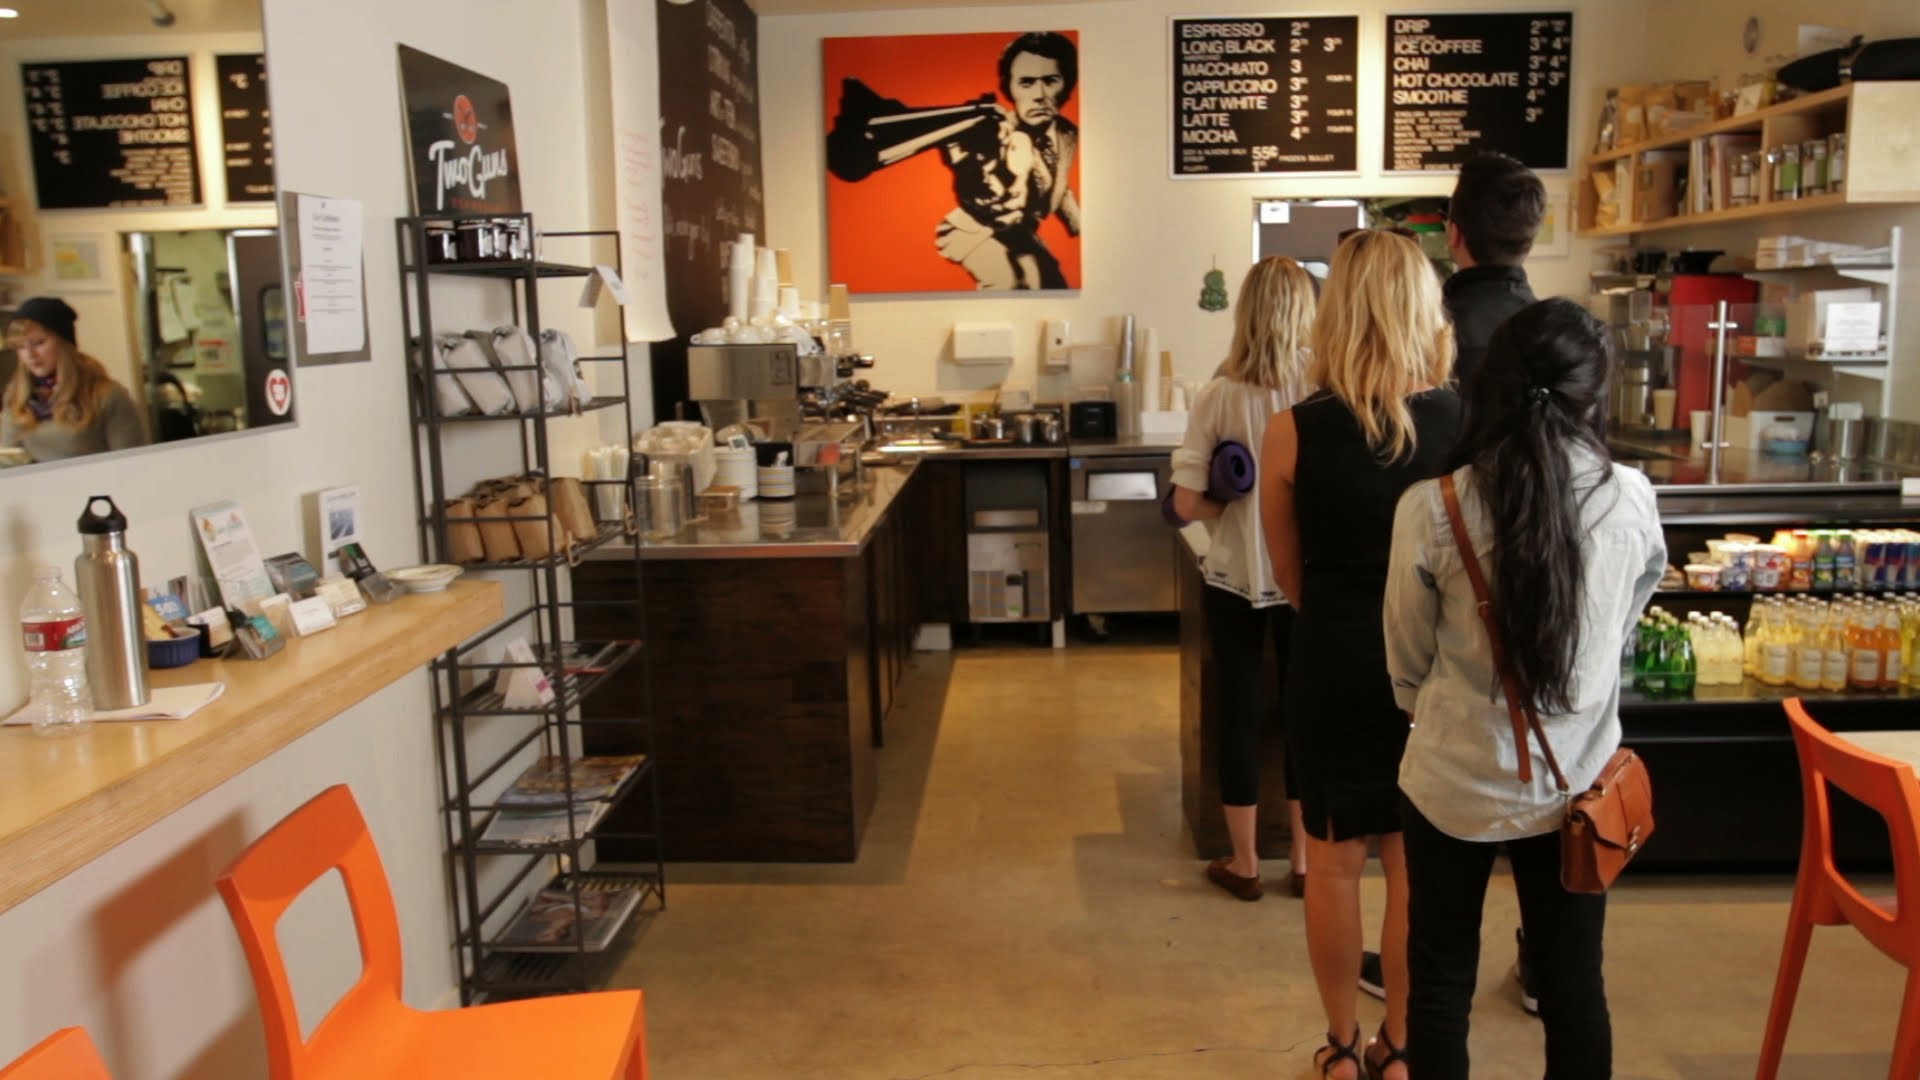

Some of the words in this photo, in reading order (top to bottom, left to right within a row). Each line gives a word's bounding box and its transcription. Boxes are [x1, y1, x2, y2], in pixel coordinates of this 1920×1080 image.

[1182, 23, 1264, 37] ESPRESSO
[1394, 20, 1429, 33] DRIP
[1181, 40, 1224, 54] LONG
[1226, 39, 1275, 53] BLACK
[1394, 41, 1419, 54] ICE
[1421, 39, 1482, 54] COFFEE
[1182, 62, 1269, 76] MACCHIATO
[1393, 57, 1429, 70] CHAI
[1183, 80, 1278, 94] CAPPUCCINO
[1393, 74, 1426, 87] HOT
[1427, 73, 1519, 87] CHOCOLATE
[1183, 97, 1217, 110] FLAT
[1220, 96, 1268, 109] WHITE
[1393, 90, 1469, 104] SMOOTHIE
[1182, 113, 1230, 127] LATTE
[1182, 130, 1238, 143] MOCHA
